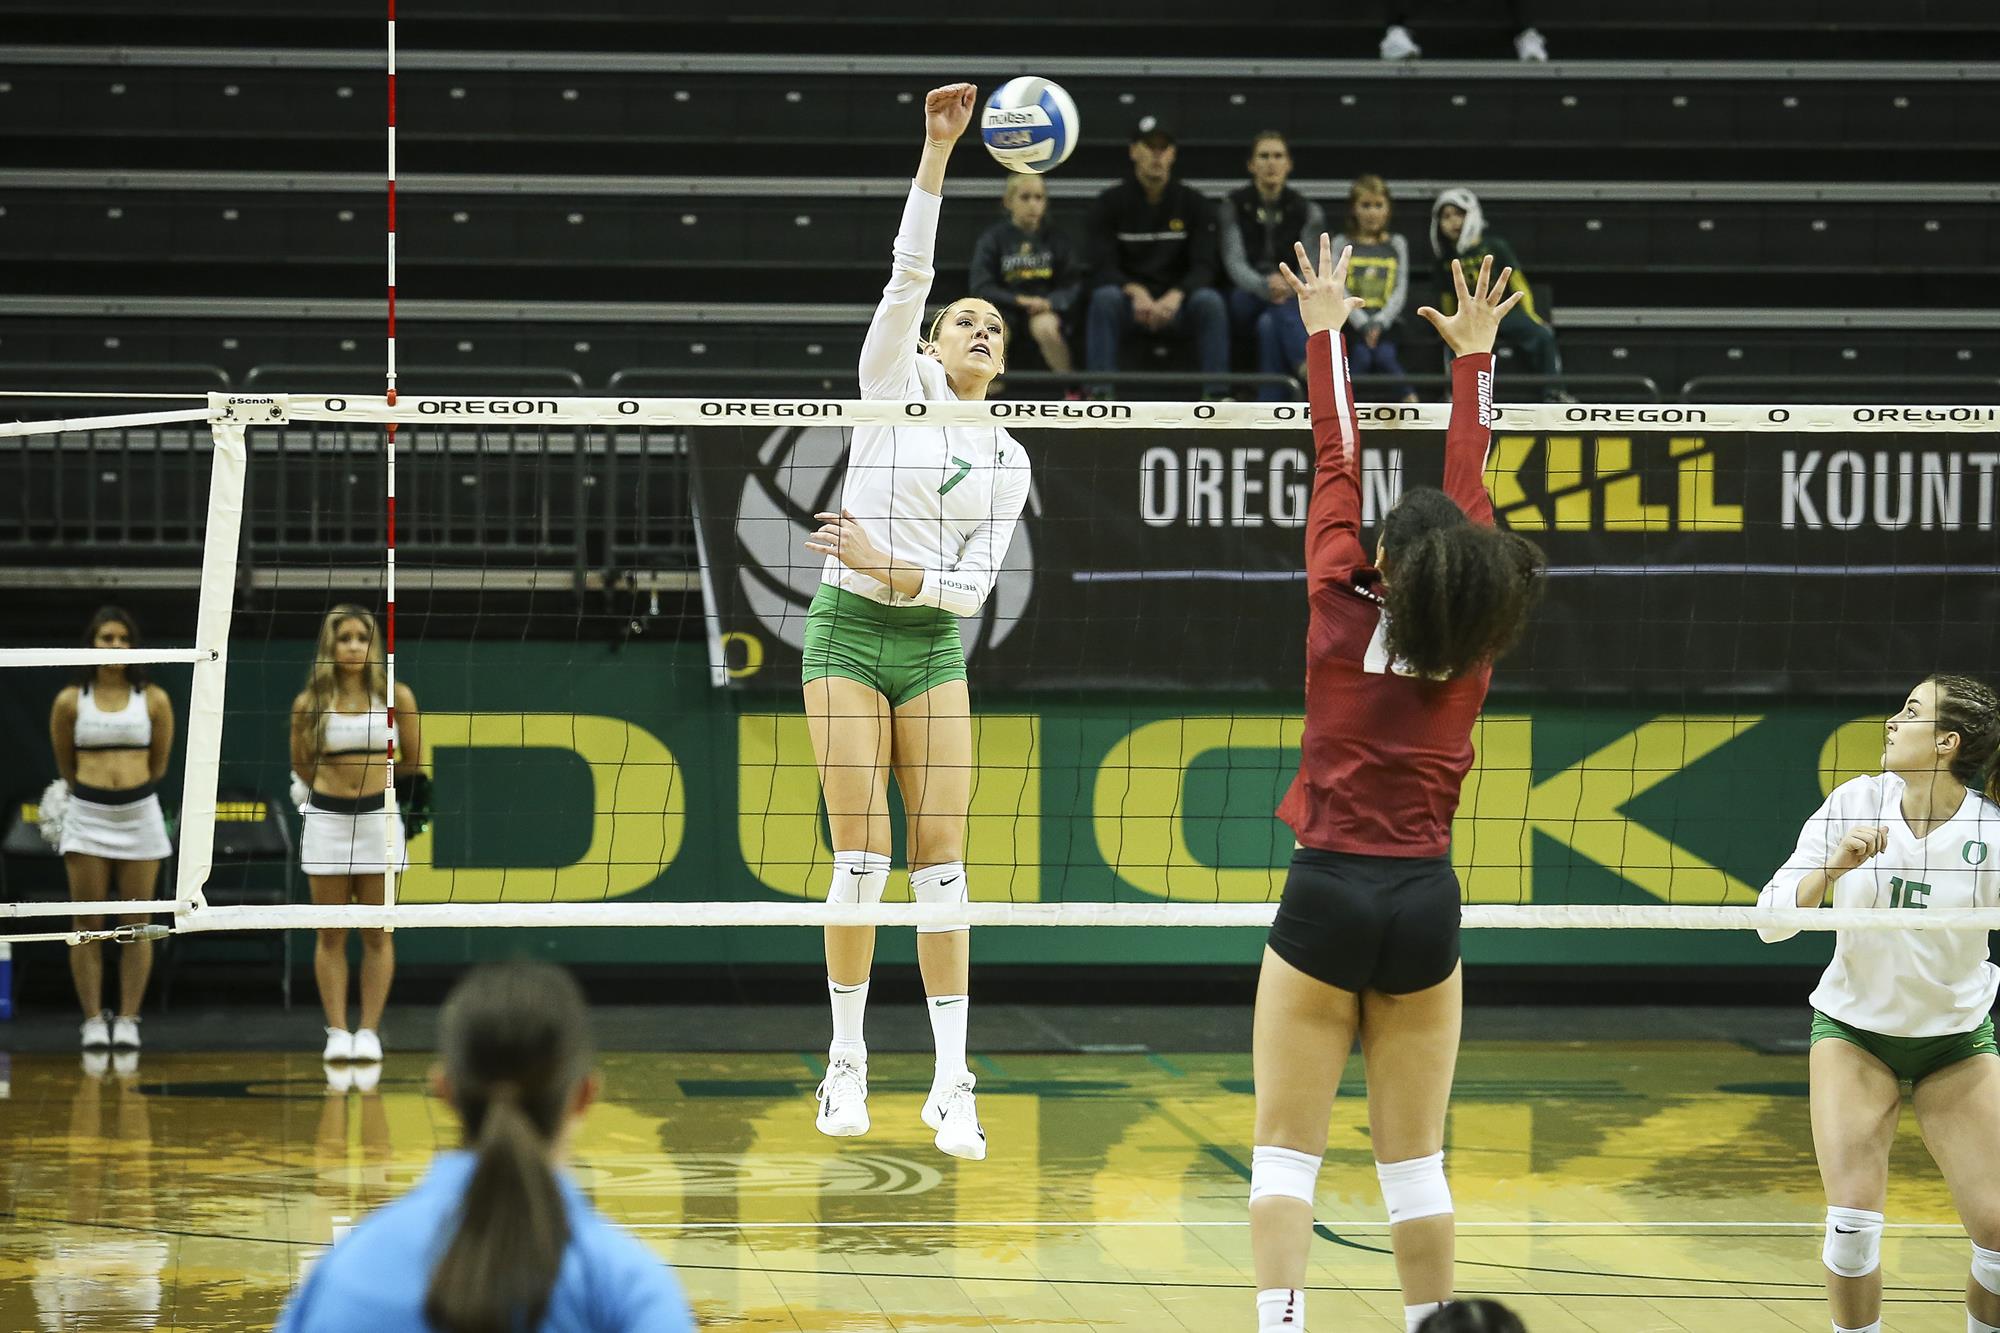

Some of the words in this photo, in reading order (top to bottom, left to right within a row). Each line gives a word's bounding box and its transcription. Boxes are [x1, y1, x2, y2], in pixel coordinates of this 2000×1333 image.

[324, 398, 347, 412] O
[417, 401, 558, 415] OREGON
[617, 400, 640, 415] O
[700, 402, 843, 417] OREGON
[905, 403, 927, 417] O
[990, 403, 1132, 418] OREGON
[1193, 405, 1216, 419] O
[1273, 406, 1420, 421] OGON
[1565, 408, 1706, 423] OREGON
[1768, 408, 1790, 422] O
[1853, 408, 1994, 422] OREGON
[1477, 370, 1491, 429] COUGARS
[937, 456, 972, 495] 7
[1138, 447, 1402, 528] OREGN
[1482, 436, 1745, 532] KILL
[1781, 450, 2000, 530] KOUNT
[721, 632, 764, 678] O
[397, 713, 1889, 903] DUCK
